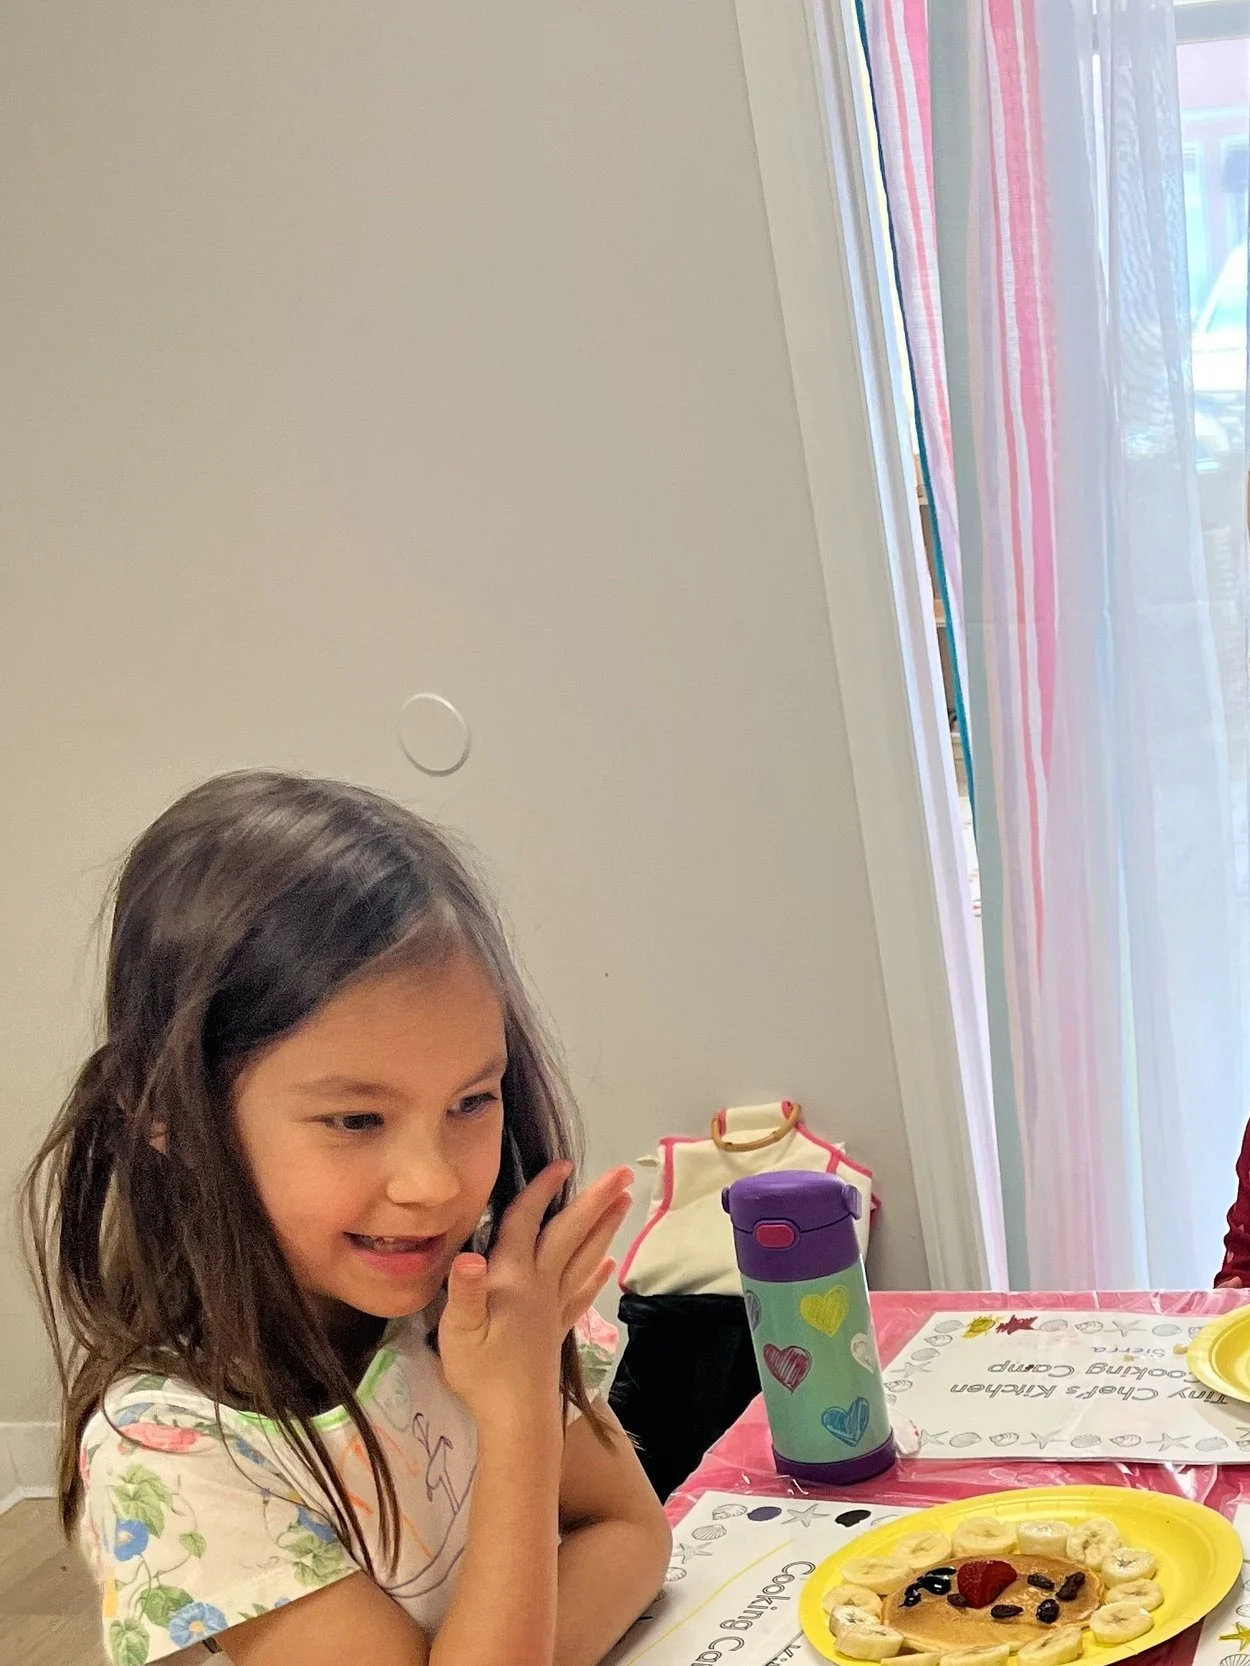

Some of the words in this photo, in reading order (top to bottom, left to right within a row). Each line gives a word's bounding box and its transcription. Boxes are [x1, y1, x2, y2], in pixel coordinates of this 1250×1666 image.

[987, 1360, 1076, 1378] Camp
[950, 1383, 1056, 1400] Kitchen
[1065, 1384, 1160, 1401] Chef's
[719, 1560, 816, 1632] Cooking
